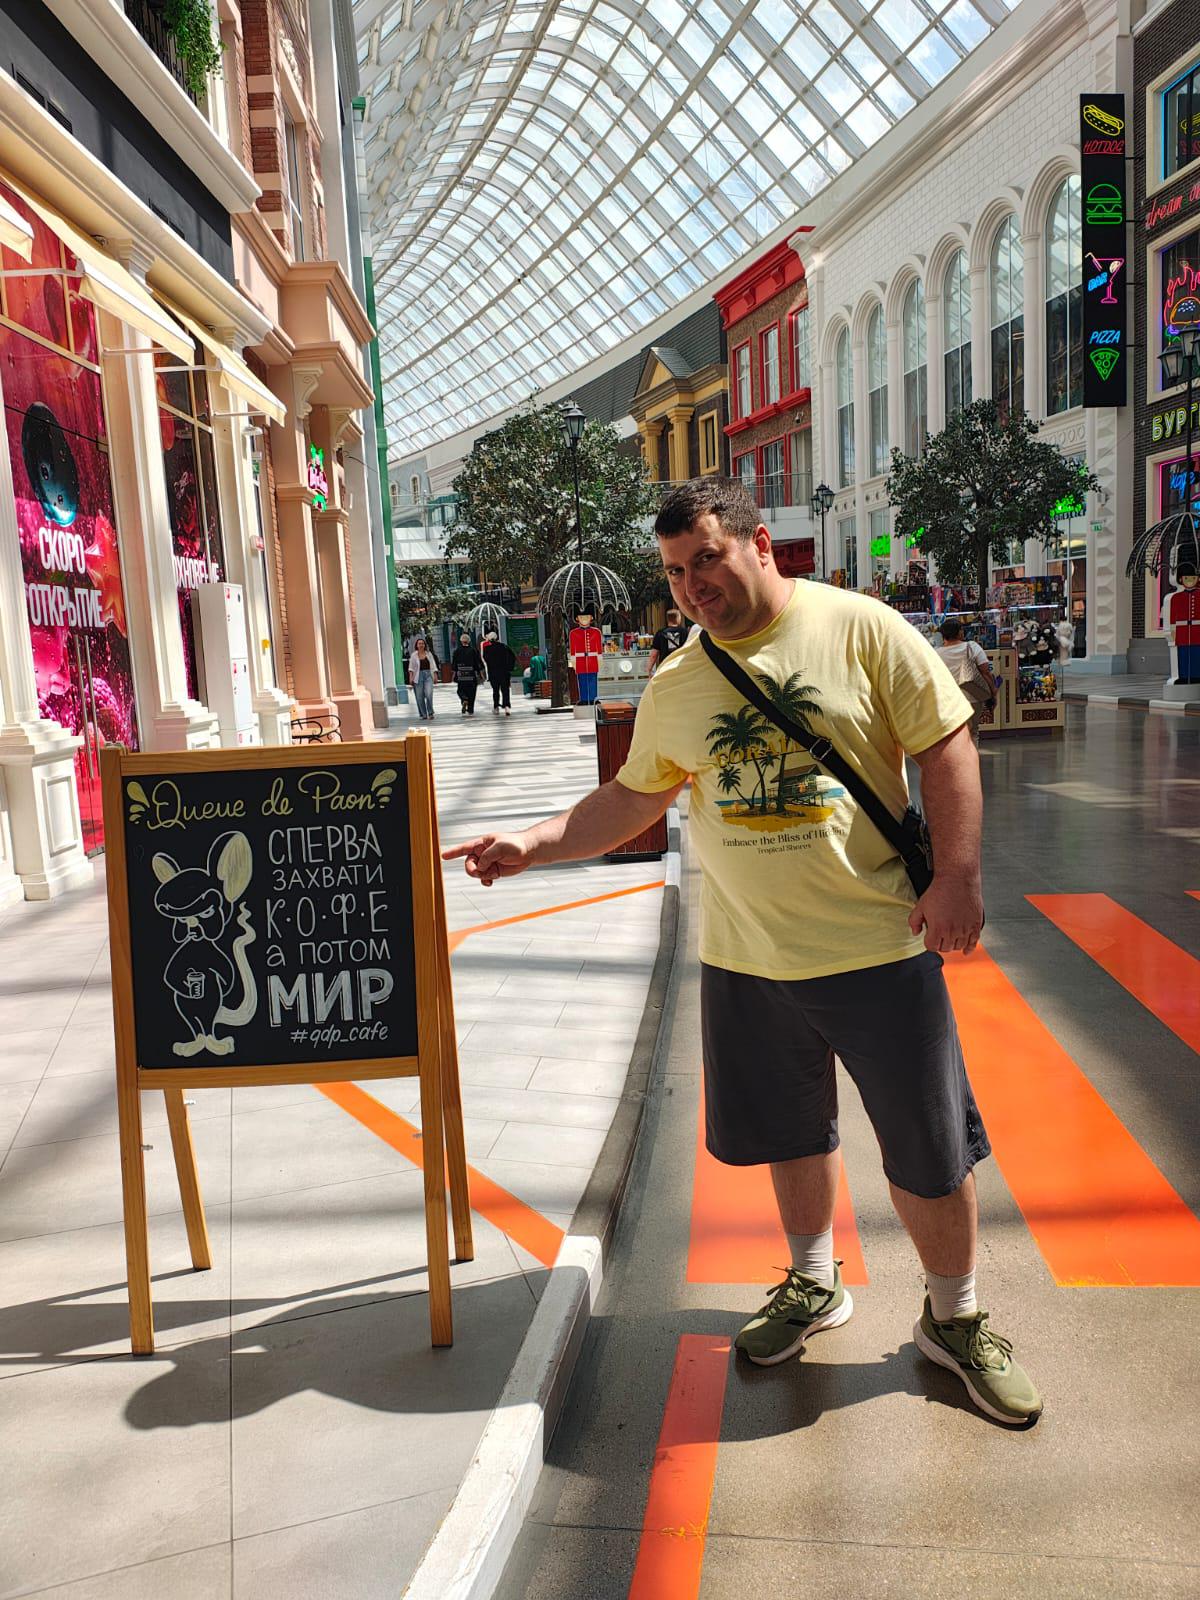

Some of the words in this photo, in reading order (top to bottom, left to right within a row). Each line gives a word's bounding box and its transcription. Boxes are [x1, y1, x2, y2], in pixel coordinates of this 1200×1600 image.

[1088, 272, 1108, 291] BAR
[1089, 330, 1121, 344] PIZZA
[1152, 402, 1200, 441] БУРГ
[38, 527, 86, 574] СКОРО
[28, 582, 105, 628] ОТКРЫТИЕ
[147, 780, 246, 829] Queue
[261, 777, 293, 816] de
[298, 771, 375, 814] Paon
[268, 823, 382, 866] СПЕРВА
[722, 837, 758, 847] Embrace
[760, 836, 776, 846] the
[778, 834, 801, 844] Bliss
[758, 846, 785, 855] Tropical
[272, 863, 384, 891] ЗАХВАТИ
[268, 968, 394, 1027] МИР
